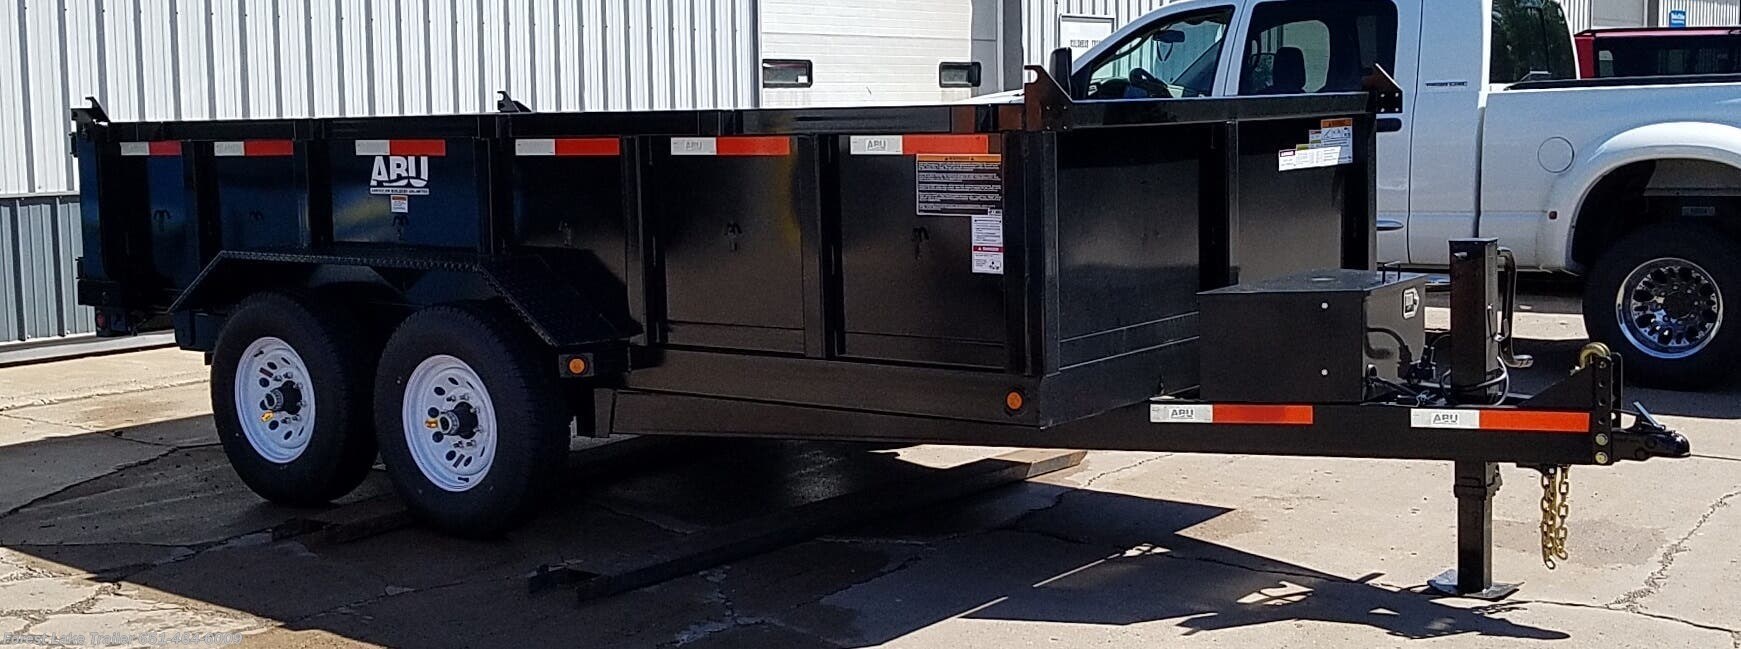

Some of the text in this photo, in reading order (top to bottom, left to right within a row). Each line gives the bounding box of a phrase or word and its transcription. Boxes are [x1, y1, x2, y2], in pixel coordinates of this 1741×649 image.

[370, 156, 428, 187] ABU
[1171, 409, 1194, 419] ABU
[1433, 414, 1459, 424] ABU
